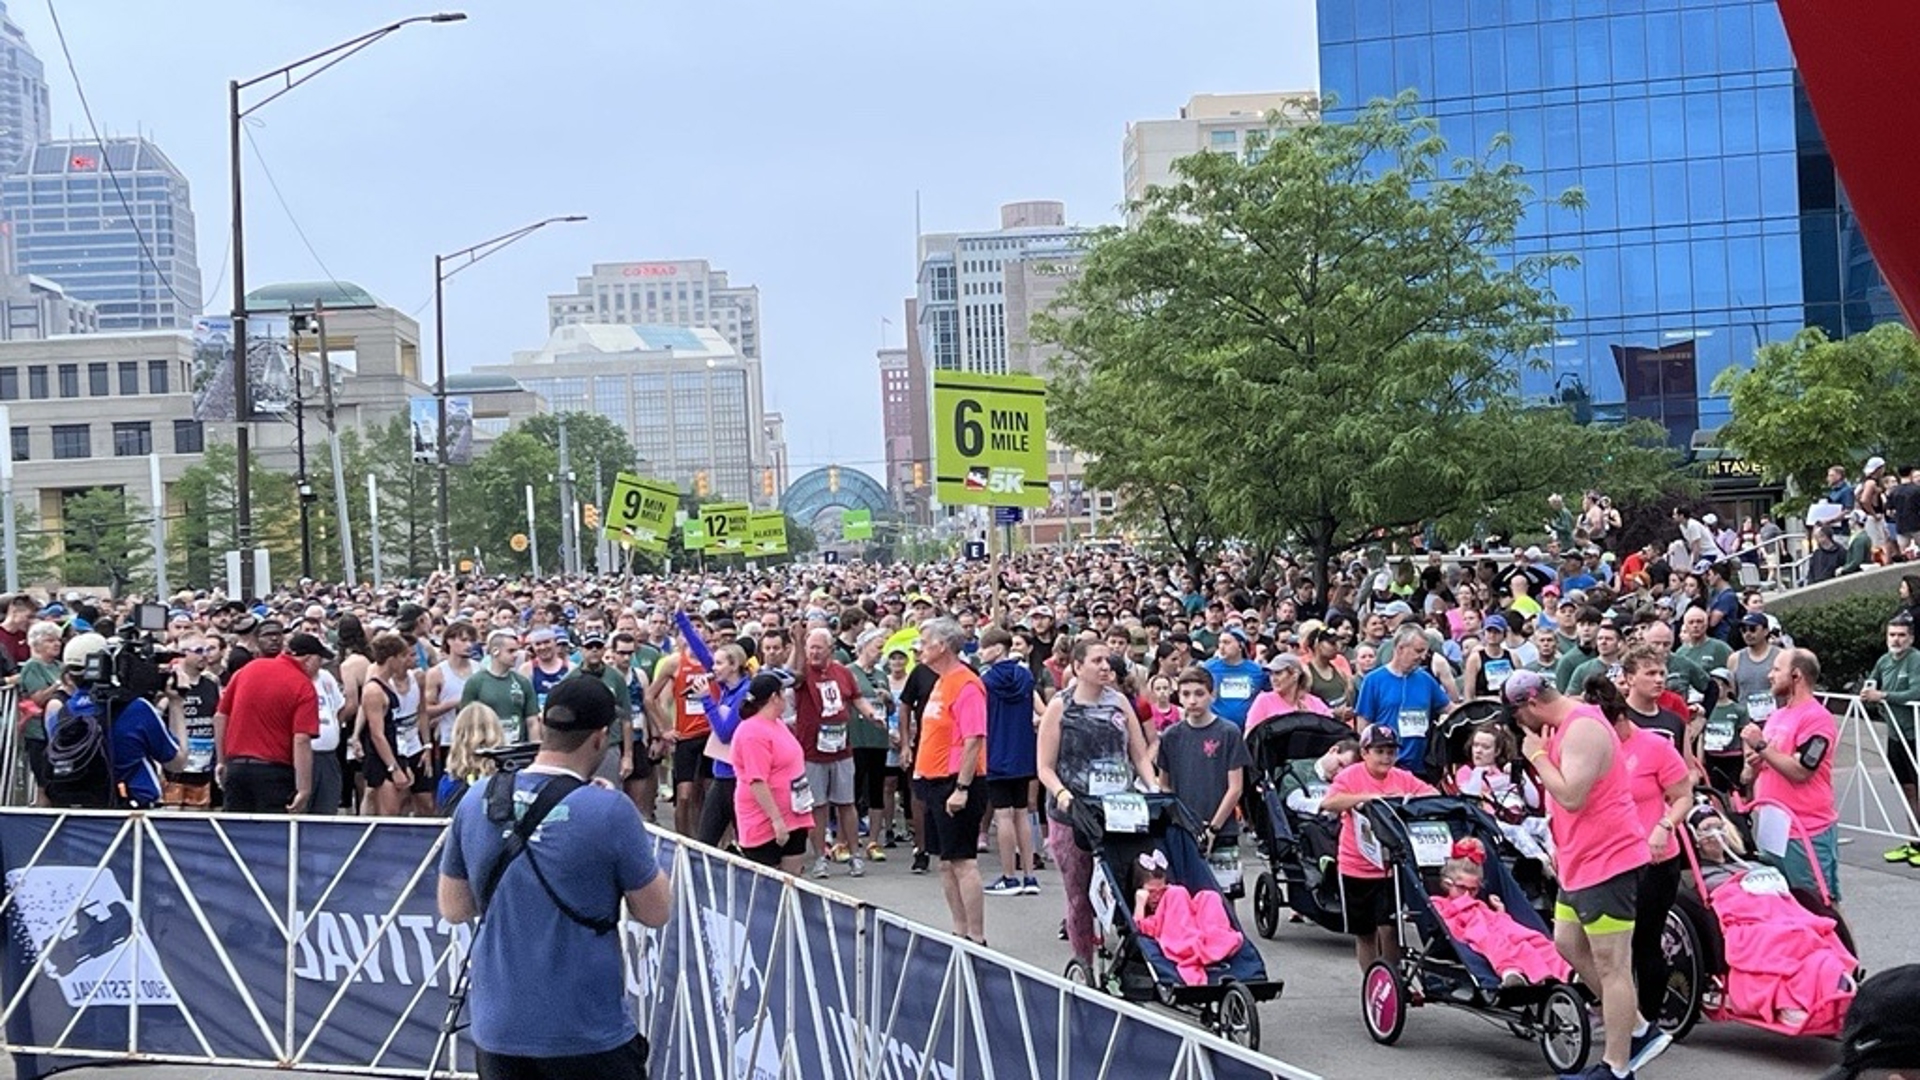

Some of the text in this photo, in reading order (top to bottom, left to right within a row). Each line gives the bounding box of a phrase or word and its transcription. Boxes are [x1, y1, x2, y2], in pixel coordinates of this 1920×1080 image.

[622, 265, 677, 277] CONRAD
[955, 399, 984, 457] 6
[991, 410, 1028, 431] MIN
[991, 433, 1029, 452] MILE
[989, 472, 1024, 493] 5K
[622, 490, 642, 519] 9
[643, 498, 667, 512] MIN
[641, 510, 663, 523] MILE
[705, 514, 728, 537] 12
[753, 528, 784, 538] ALKERS
[971, 545, 979, 557] E
[1110, 802, 1142, 811] 51271
